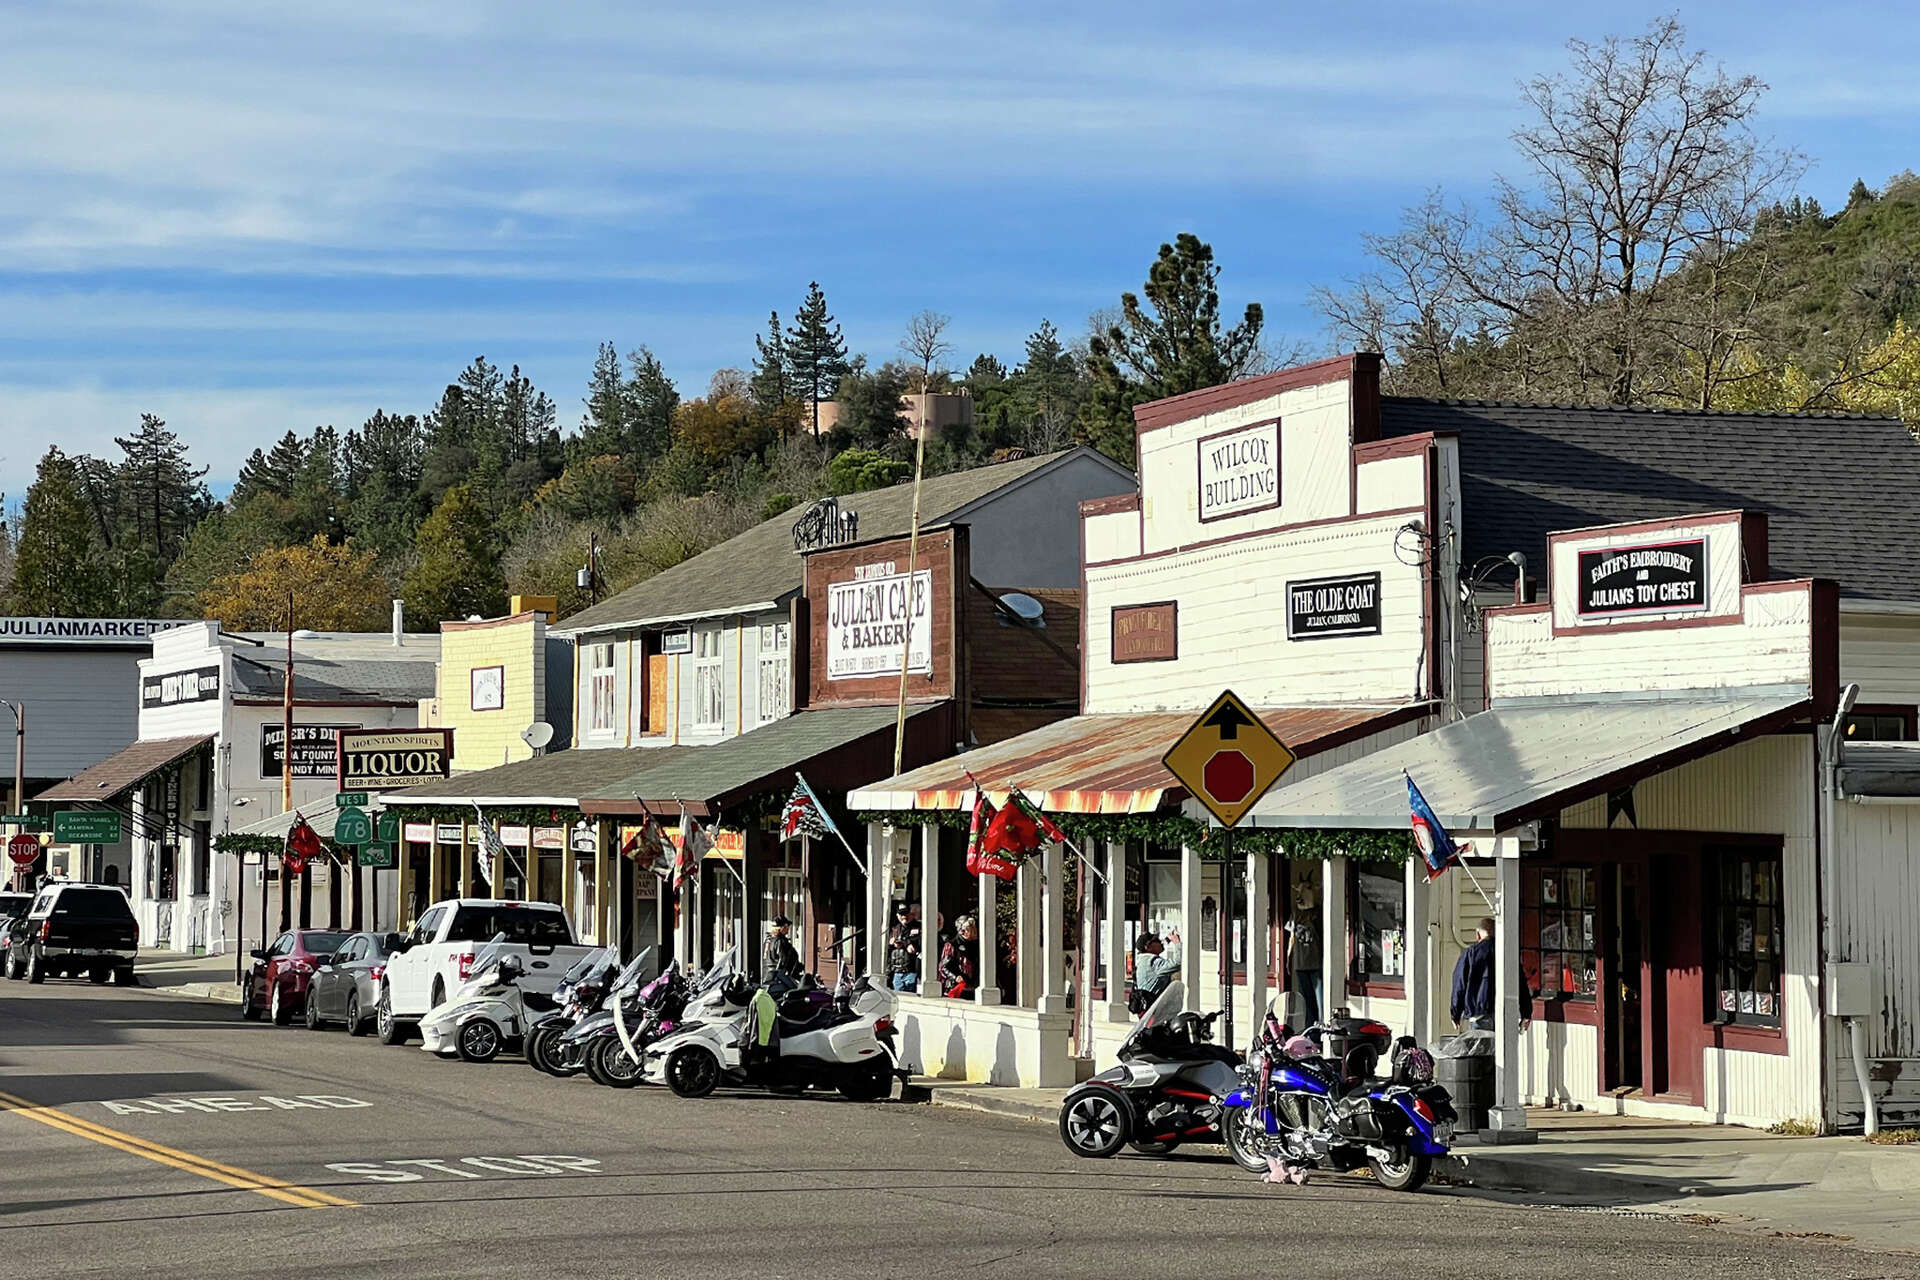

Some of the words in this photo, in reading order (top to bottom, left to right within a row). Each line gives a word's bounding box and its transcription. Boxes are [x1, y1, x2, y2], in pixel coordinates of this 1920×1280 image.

[1212, 438, 1269, 473] WILCOX
[1206, 468, 1275, 508] BUILDING
[1591, 554, 1629, 584] FAITH'S
[1630, 551, 1694, 573] EMBROIDERY
[1636, 569, 1649, 581] AND
[1293, 590, 1315, 615] THE
[1315, 587, 1344, 612] OLDE
[1345, 584, 1376, 610] GOAT
[1636, 583, 1658, 603] TOY
[1659, 581, 1697, 600] CHEST
[832, 584, 884, 629] JULIAN
[351, 736, 403, 749] MOUNTAIN
[404, 735, 440, 747] SPIRITS
[273, 751, 299, 761] SOA
[347, 751, 442, 776] LIQUOR
[367, 778, 382, 786] WINE
[386, 777, 420, 786] GROCERIES
[338, 795, 365, 804] WEST
[340, 821, 366, 838] 78
[384, 820, 396, 838] 7
[9, 843, 38, 856] STOP
[101, 1095, 374, 1115] AHEAD
[323, 1154, 603, 1182] STOP
